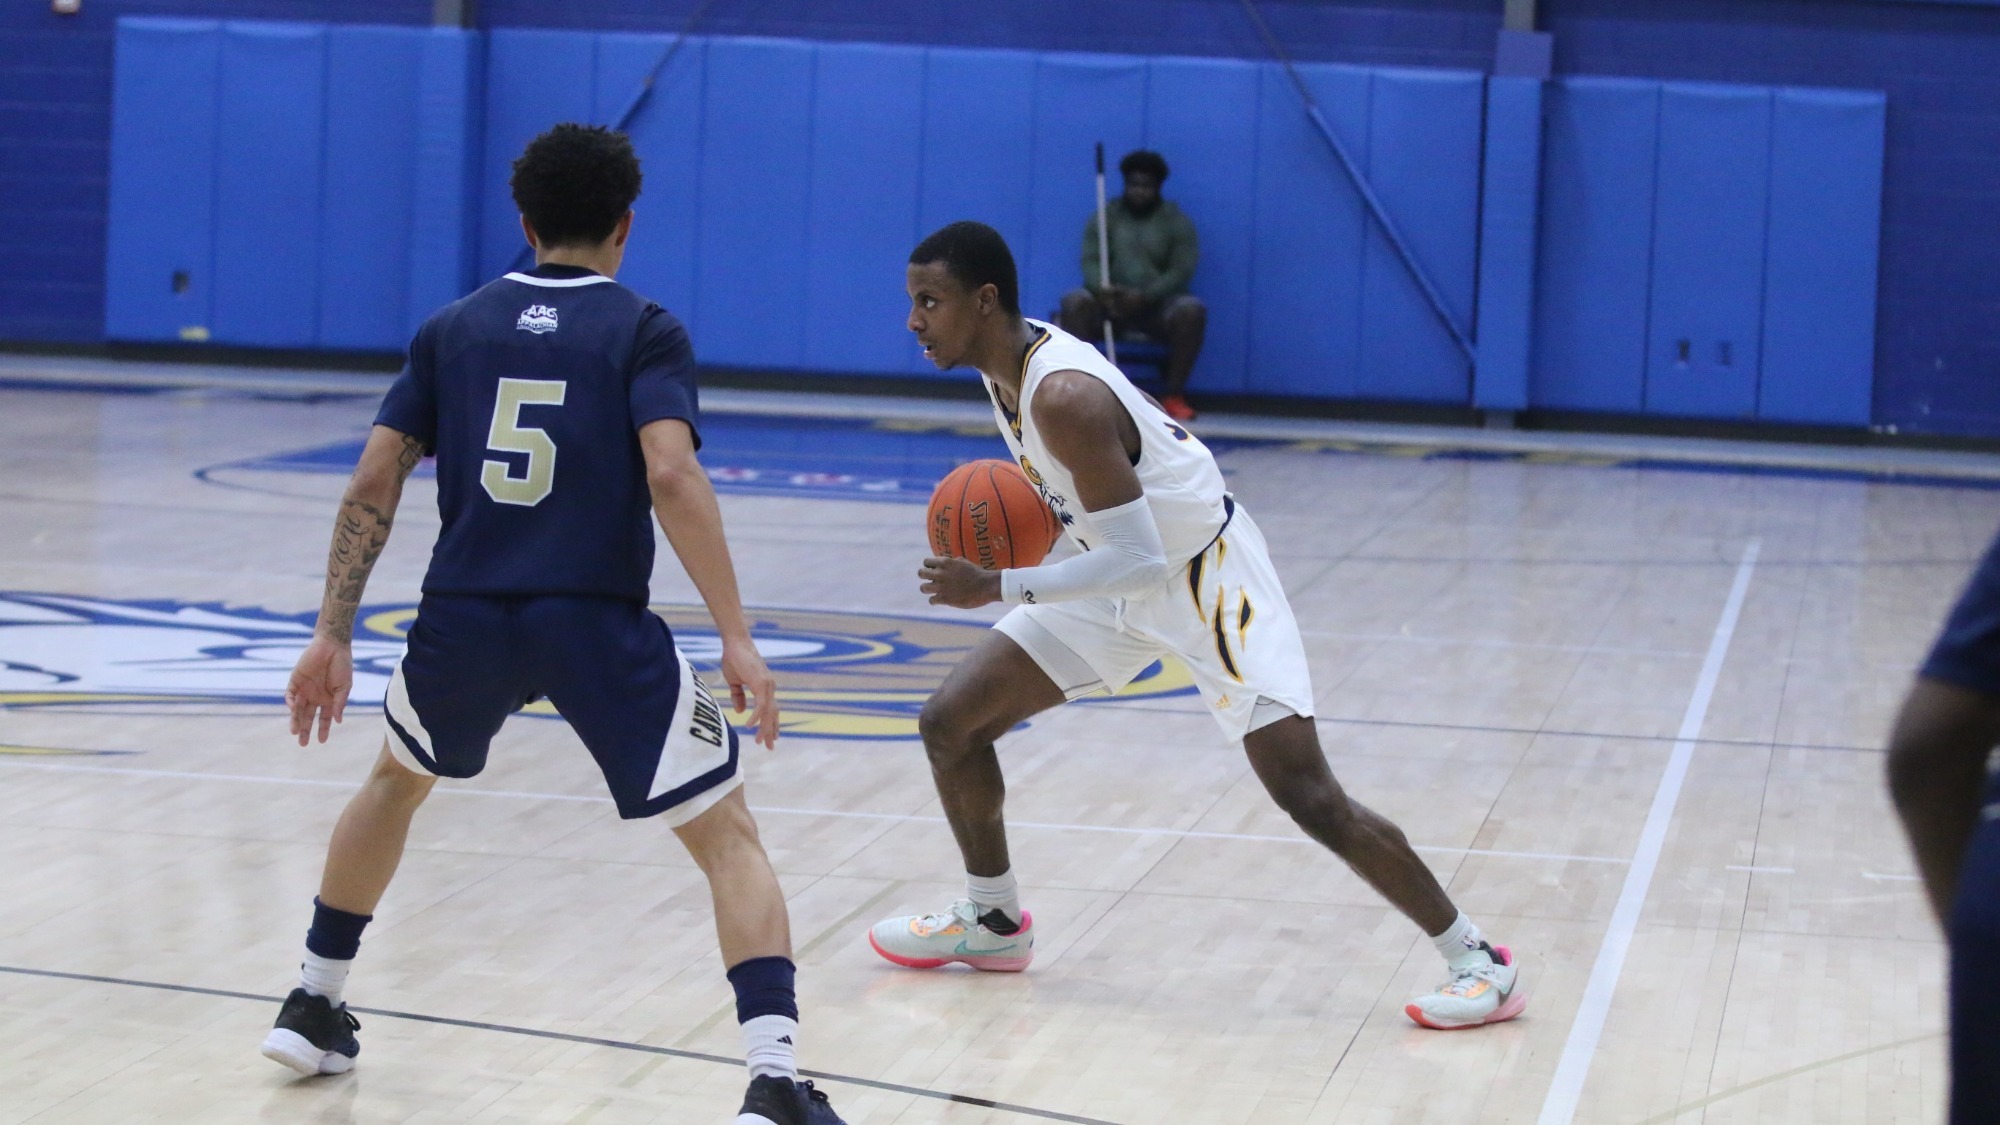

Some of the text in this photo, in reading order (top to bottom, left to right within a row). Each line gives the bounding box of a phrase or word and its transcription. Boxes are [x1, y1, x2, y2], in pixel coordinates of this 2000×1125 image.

[527, 304, 557, 318] AAC
[480, 377, 567, 507] 5
[968, 500, 998, 570] SPALDIN
